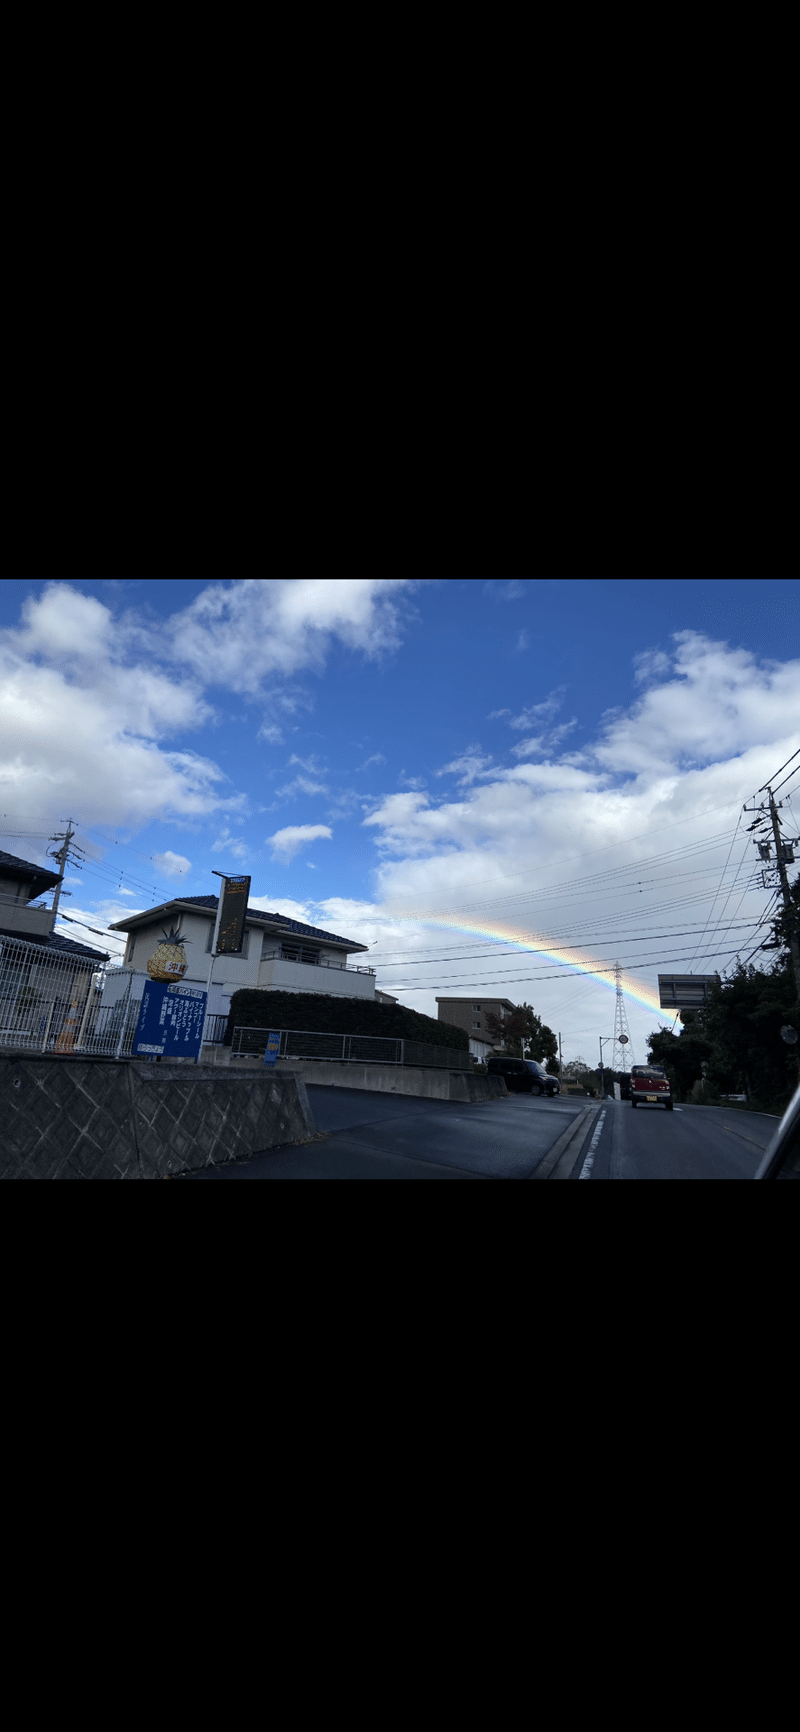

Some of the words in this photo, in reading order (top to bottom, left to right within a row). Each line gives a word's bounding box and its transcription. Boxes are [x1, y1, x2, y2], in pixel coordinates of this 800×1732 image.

[174, 1000, 184, 1041] オリオンビール
[195, 1003, 204, 1039] ブルーシール
